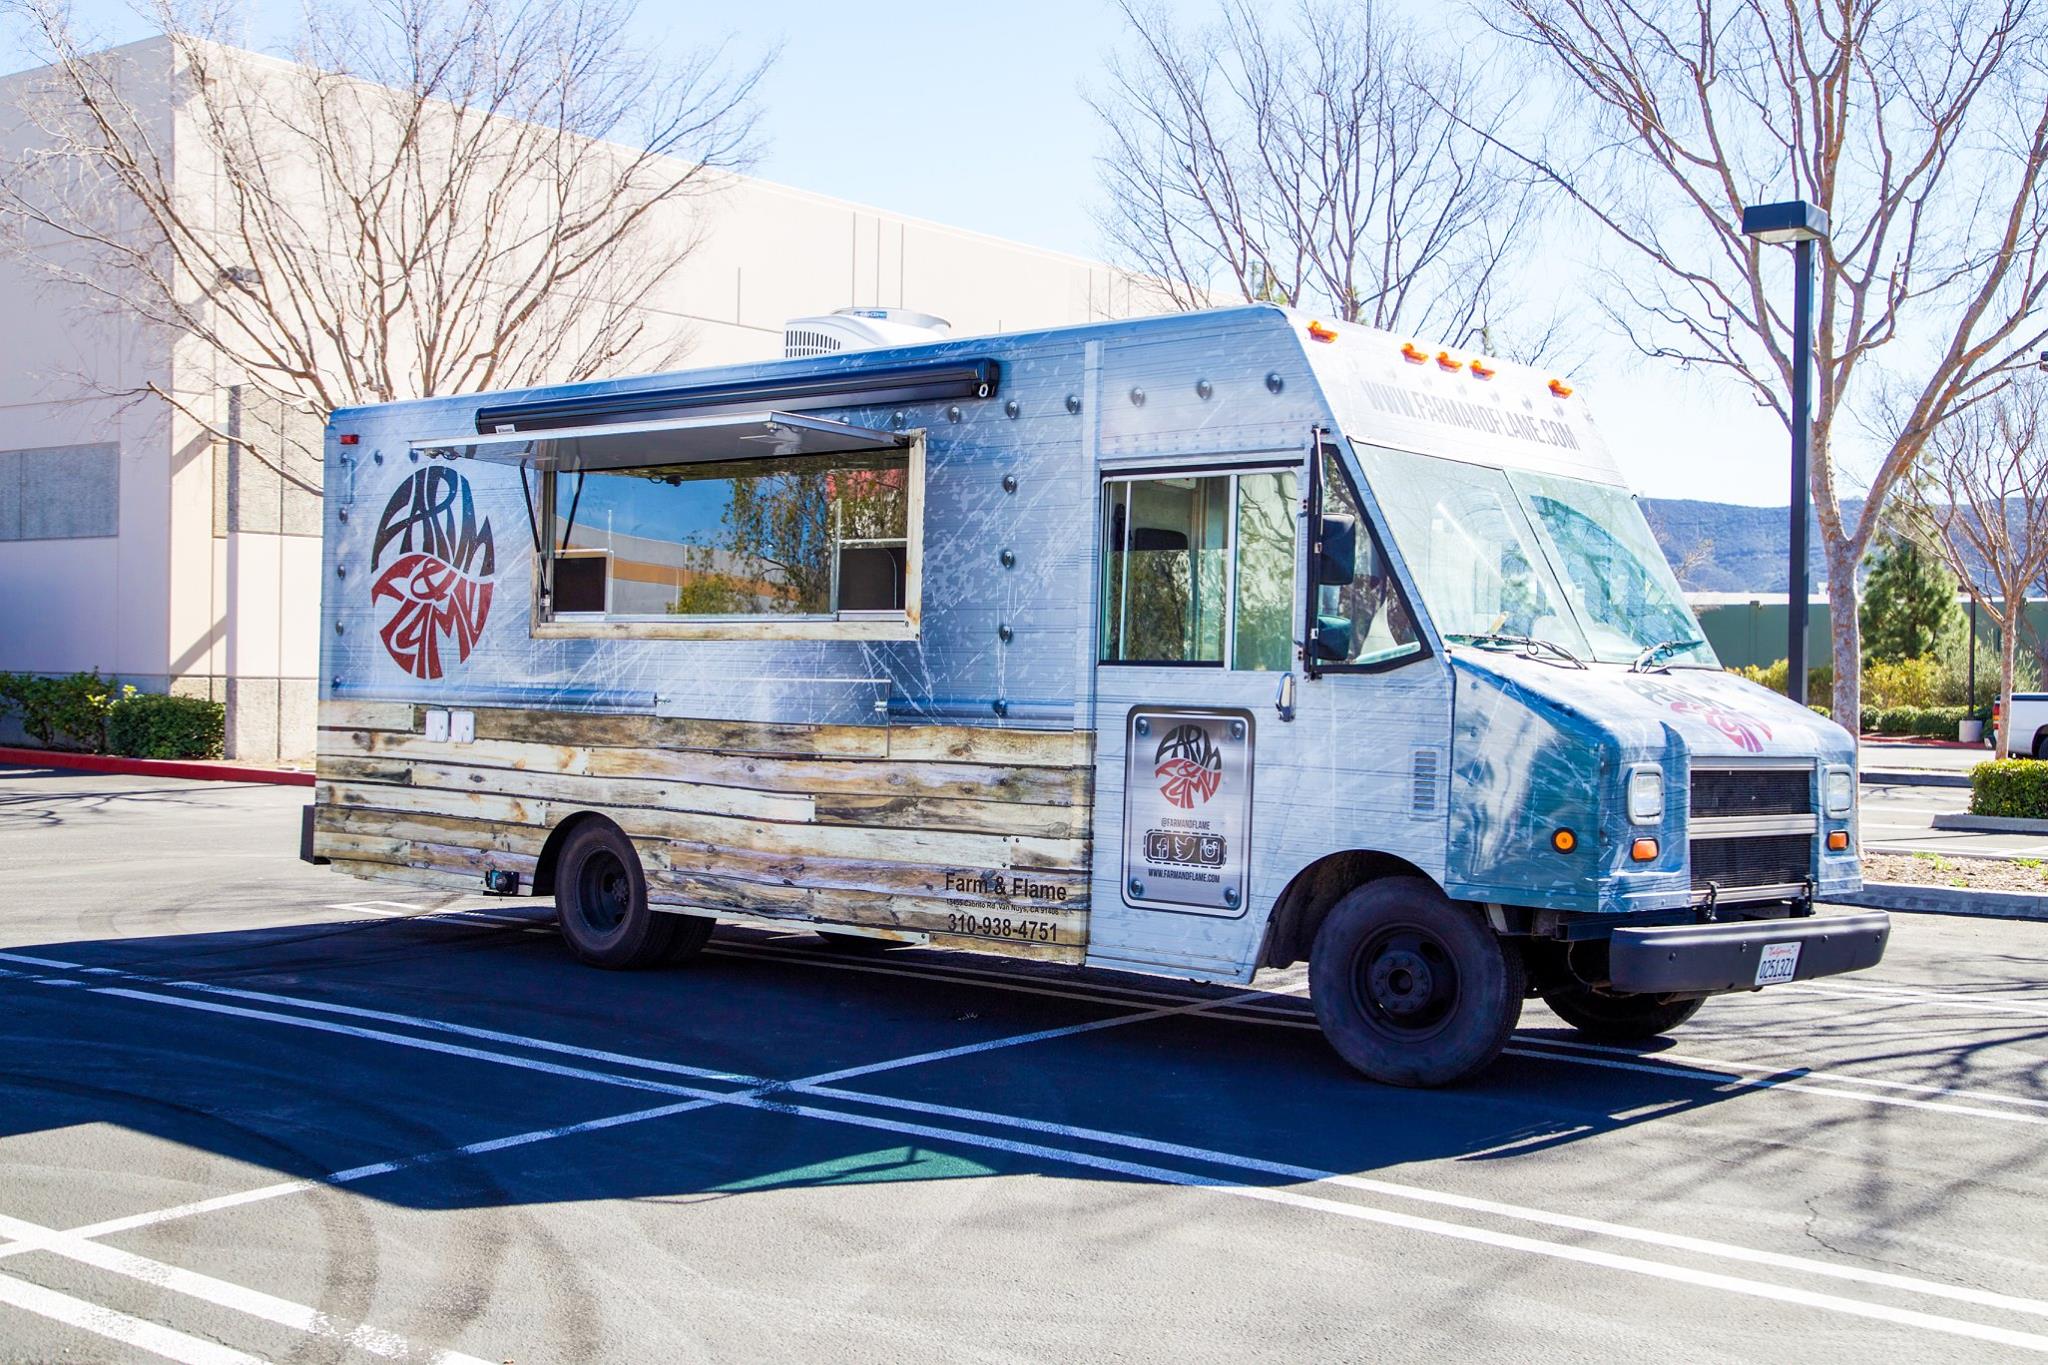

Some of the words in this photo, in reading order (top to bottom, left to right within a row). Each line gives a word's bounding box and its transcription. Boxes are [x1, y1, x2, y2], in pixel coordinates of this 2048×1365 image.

[1361, 380, 1581, 451] WWW.FARMANDFLAME.COM
[371, 465, 495, 577] FARM
[1154, 724, 1222, 771] FARM
[1161, 818, 1210, 830] @FARMANDFLAME
[945, 872, 988, 894] Farm
[994, 876, 1006, 895] &
[1013, 878, 1067, 901] Flame
[1148, 868, 1220, 883] WWW.FARMANDFLAME.COM
[948, 913, 1057, 942] 310-938-4751
